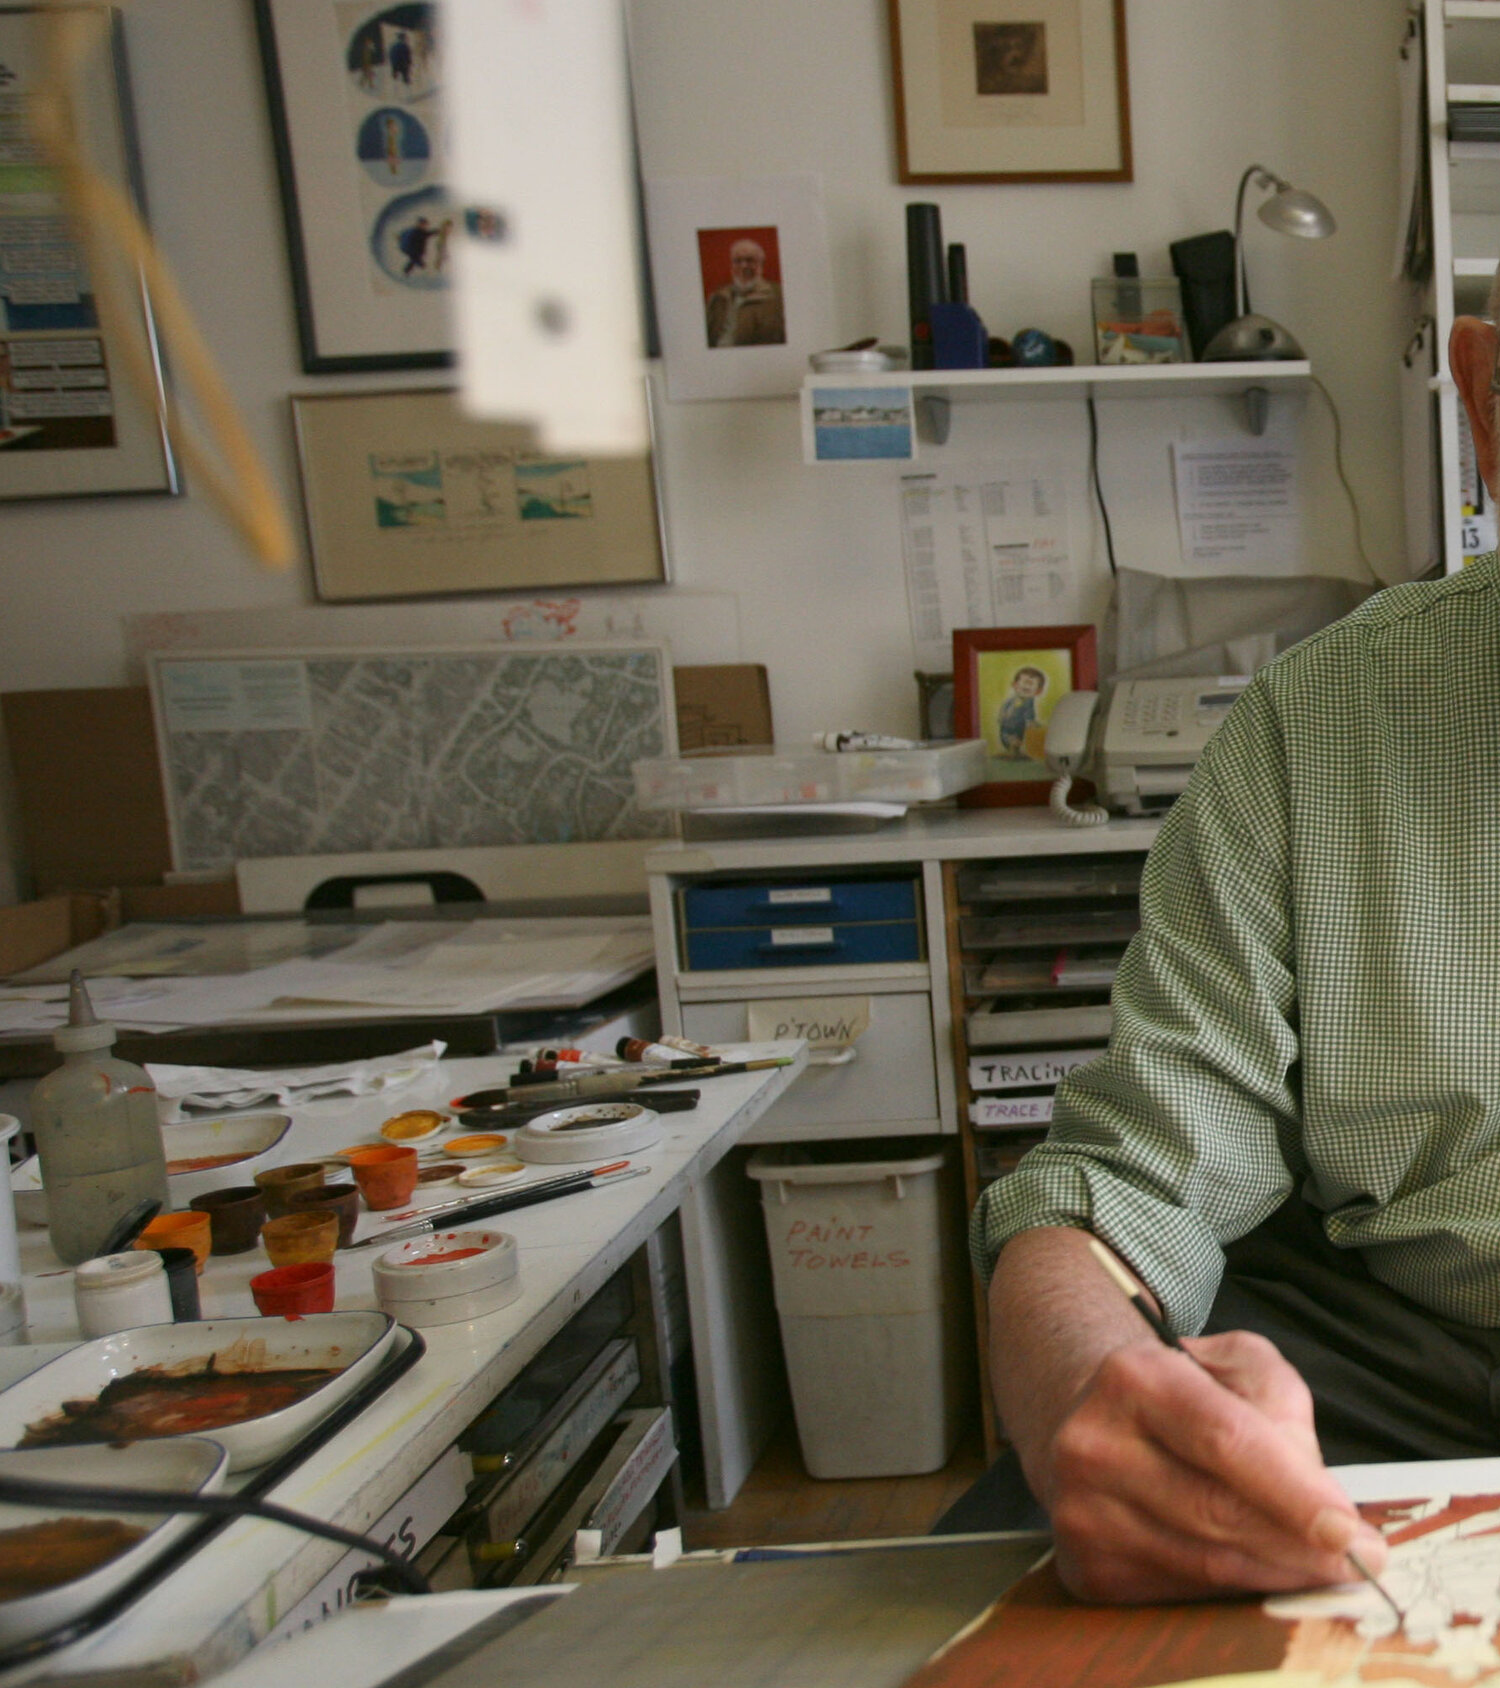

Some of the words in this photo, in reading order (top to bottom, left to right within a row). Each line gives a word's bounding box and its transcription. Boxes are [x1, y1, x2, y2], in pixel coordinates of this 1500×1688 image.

[774, 1016, 859, 1041] P'TOWN
[985, 1103, 1040, 1118] TRACE
[788, 1249, 911, 1269] TOWELS
